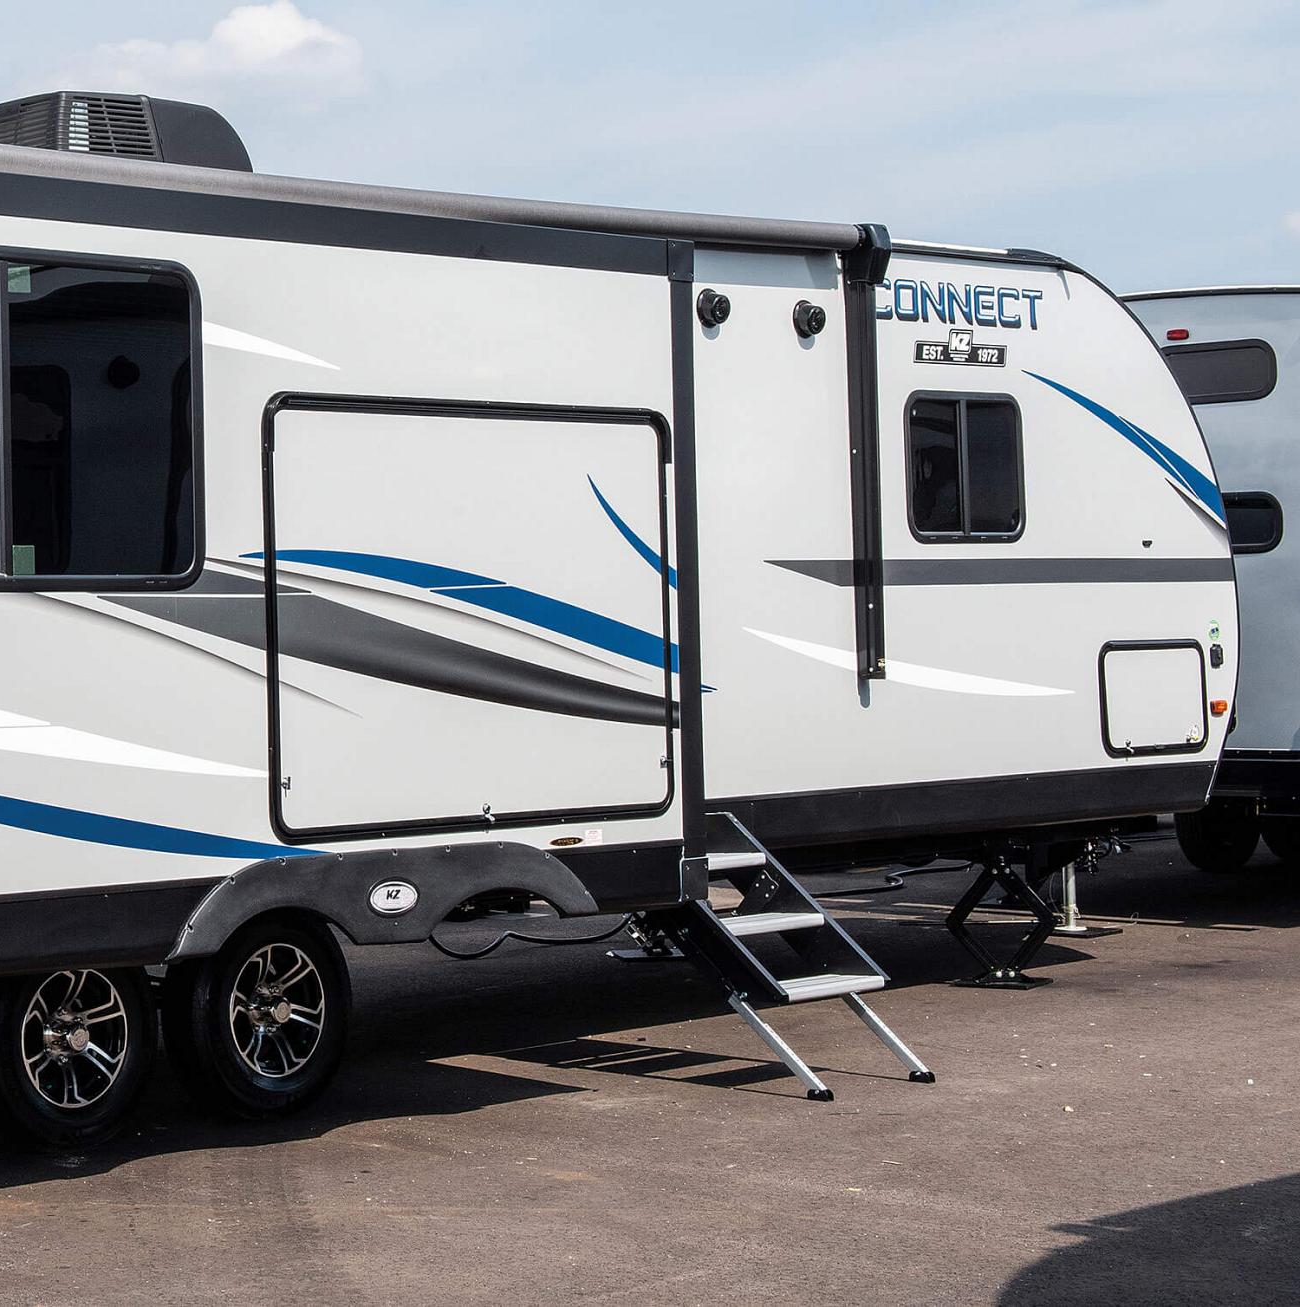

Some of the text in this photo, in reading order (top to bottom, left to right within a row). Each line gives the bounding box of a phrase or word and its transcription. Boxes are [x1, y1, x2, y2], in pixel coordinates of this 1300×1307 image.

[876, 278, 1043, 330] CONNECT
[950, 332, 971, 351] KZ
[922, 345, 944, 360] EST.
[977, 348, 999, 362] 1972
[386, 889, 401, 900] KZ
